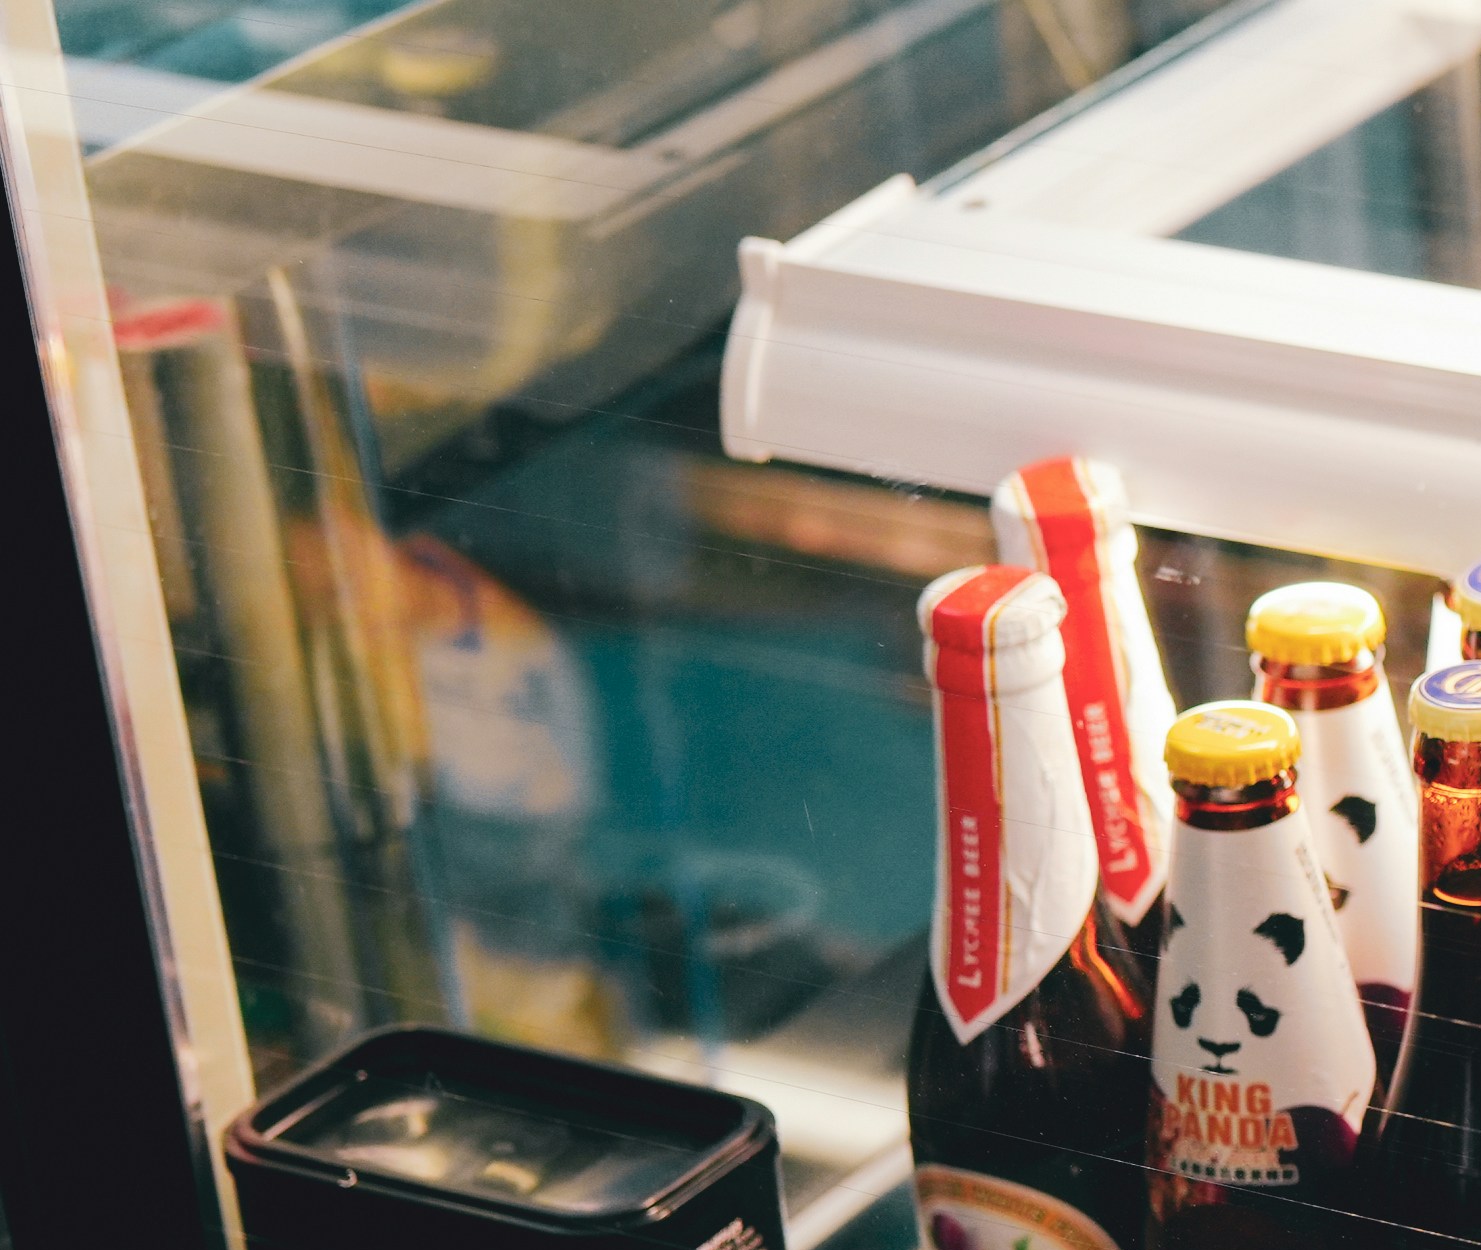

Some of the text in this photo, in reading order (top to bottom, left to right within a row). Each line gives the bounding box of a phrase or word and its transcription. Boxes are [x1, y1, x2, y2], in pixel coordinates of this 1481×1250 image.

[960, 816, 981, 988] LYCHEE BEER
[1177, 1073, 1272, 1115] KING
[1161, 1102, 1298, 1149] PANDA
